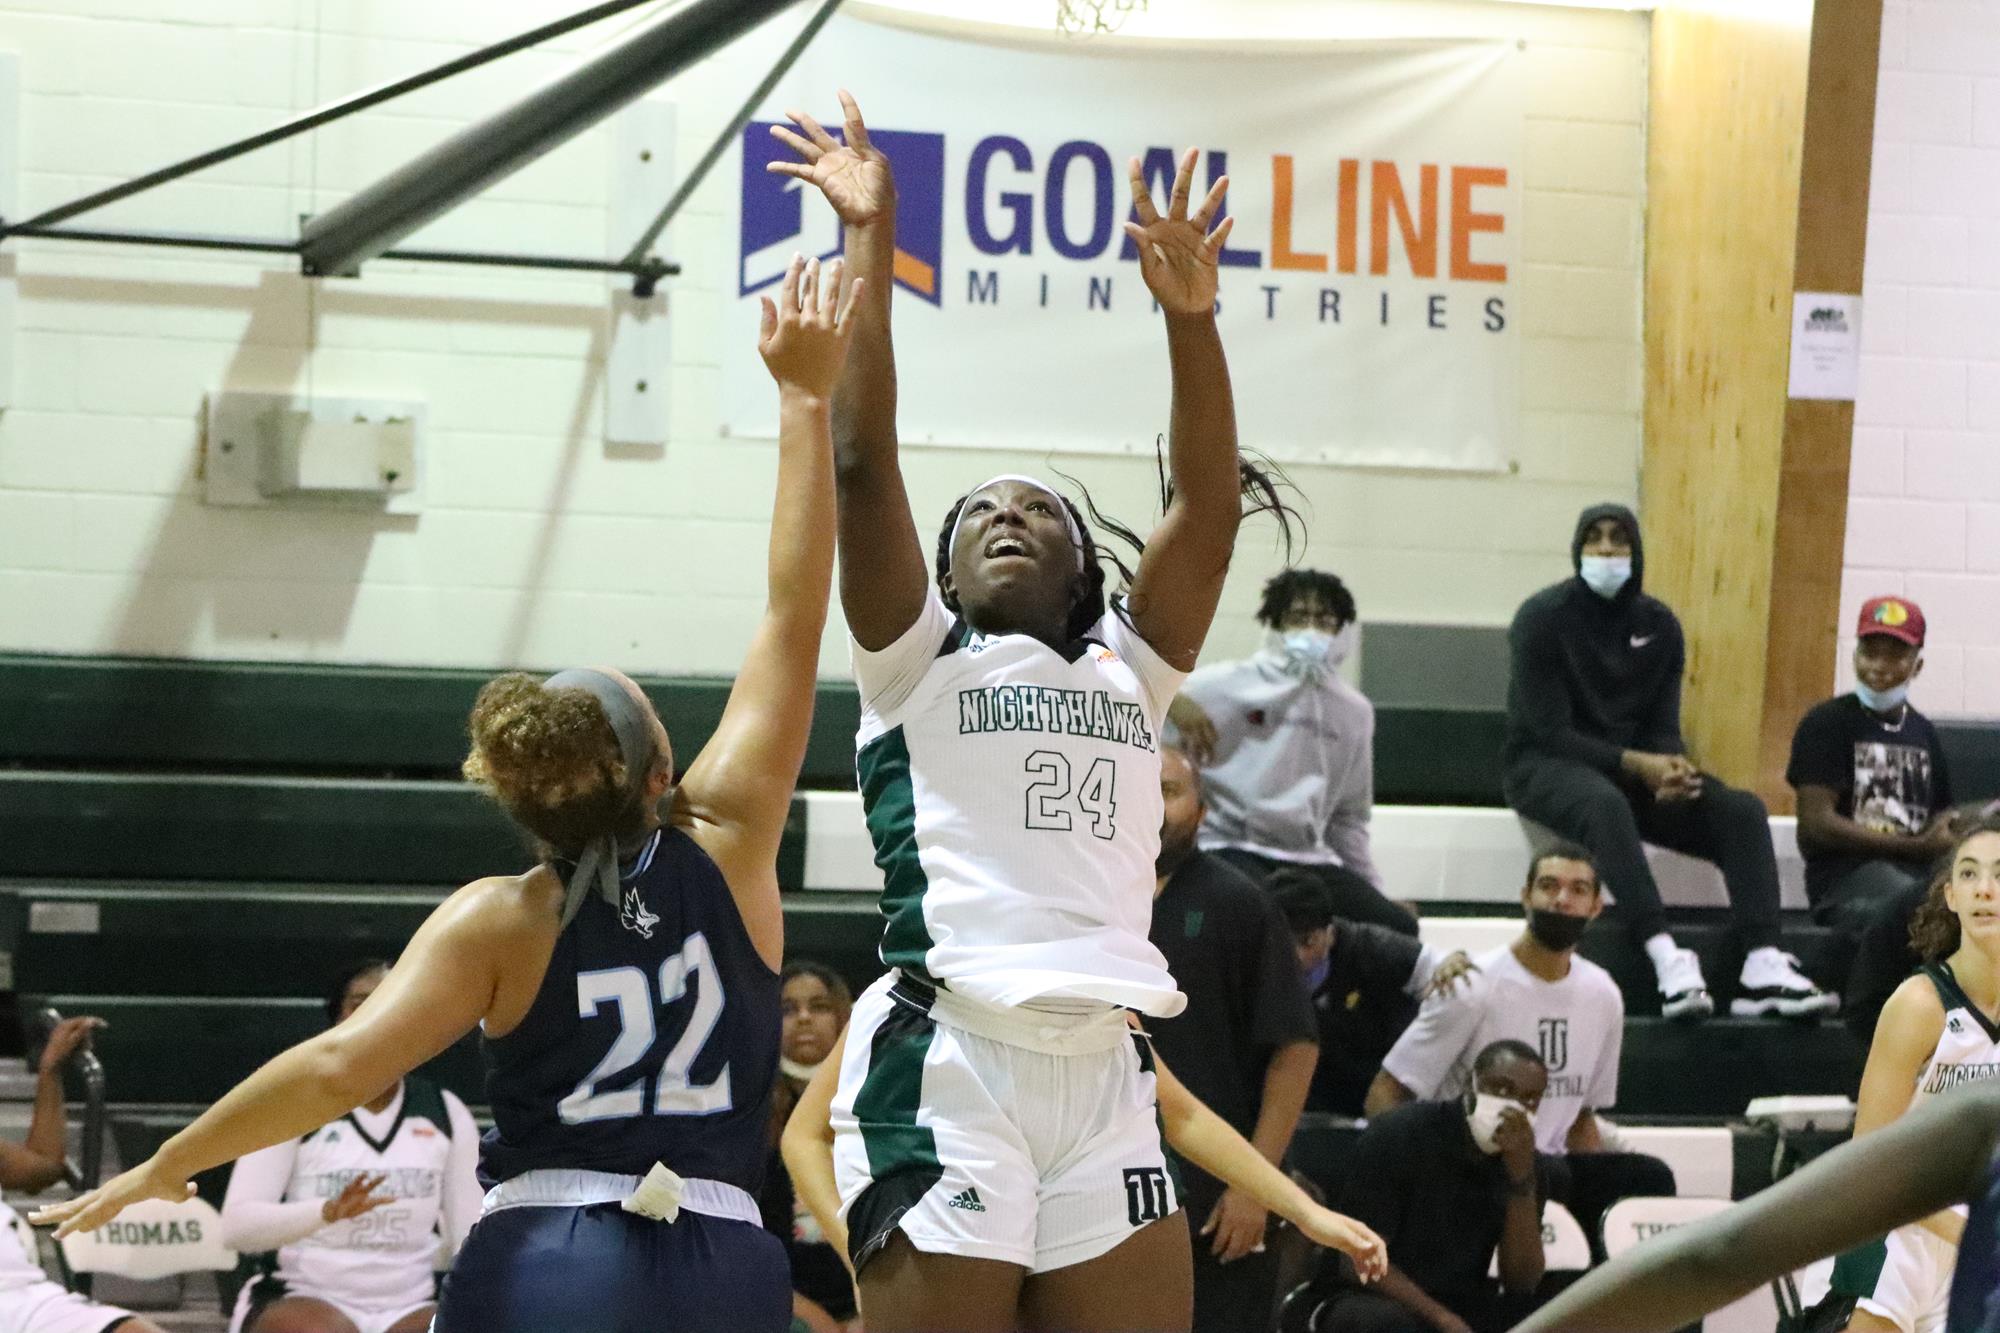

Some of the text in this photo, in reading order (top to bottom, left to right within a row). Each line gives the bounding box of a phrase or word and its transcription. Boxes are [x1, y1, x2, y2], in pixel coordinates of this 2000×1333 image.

[967, 269, 1506, 333] MINTRIES
[1025, 750, 1116, 840] 24
[557, 930, 733, 1125] 22
[948, 1199, 986, 1213] adidas
